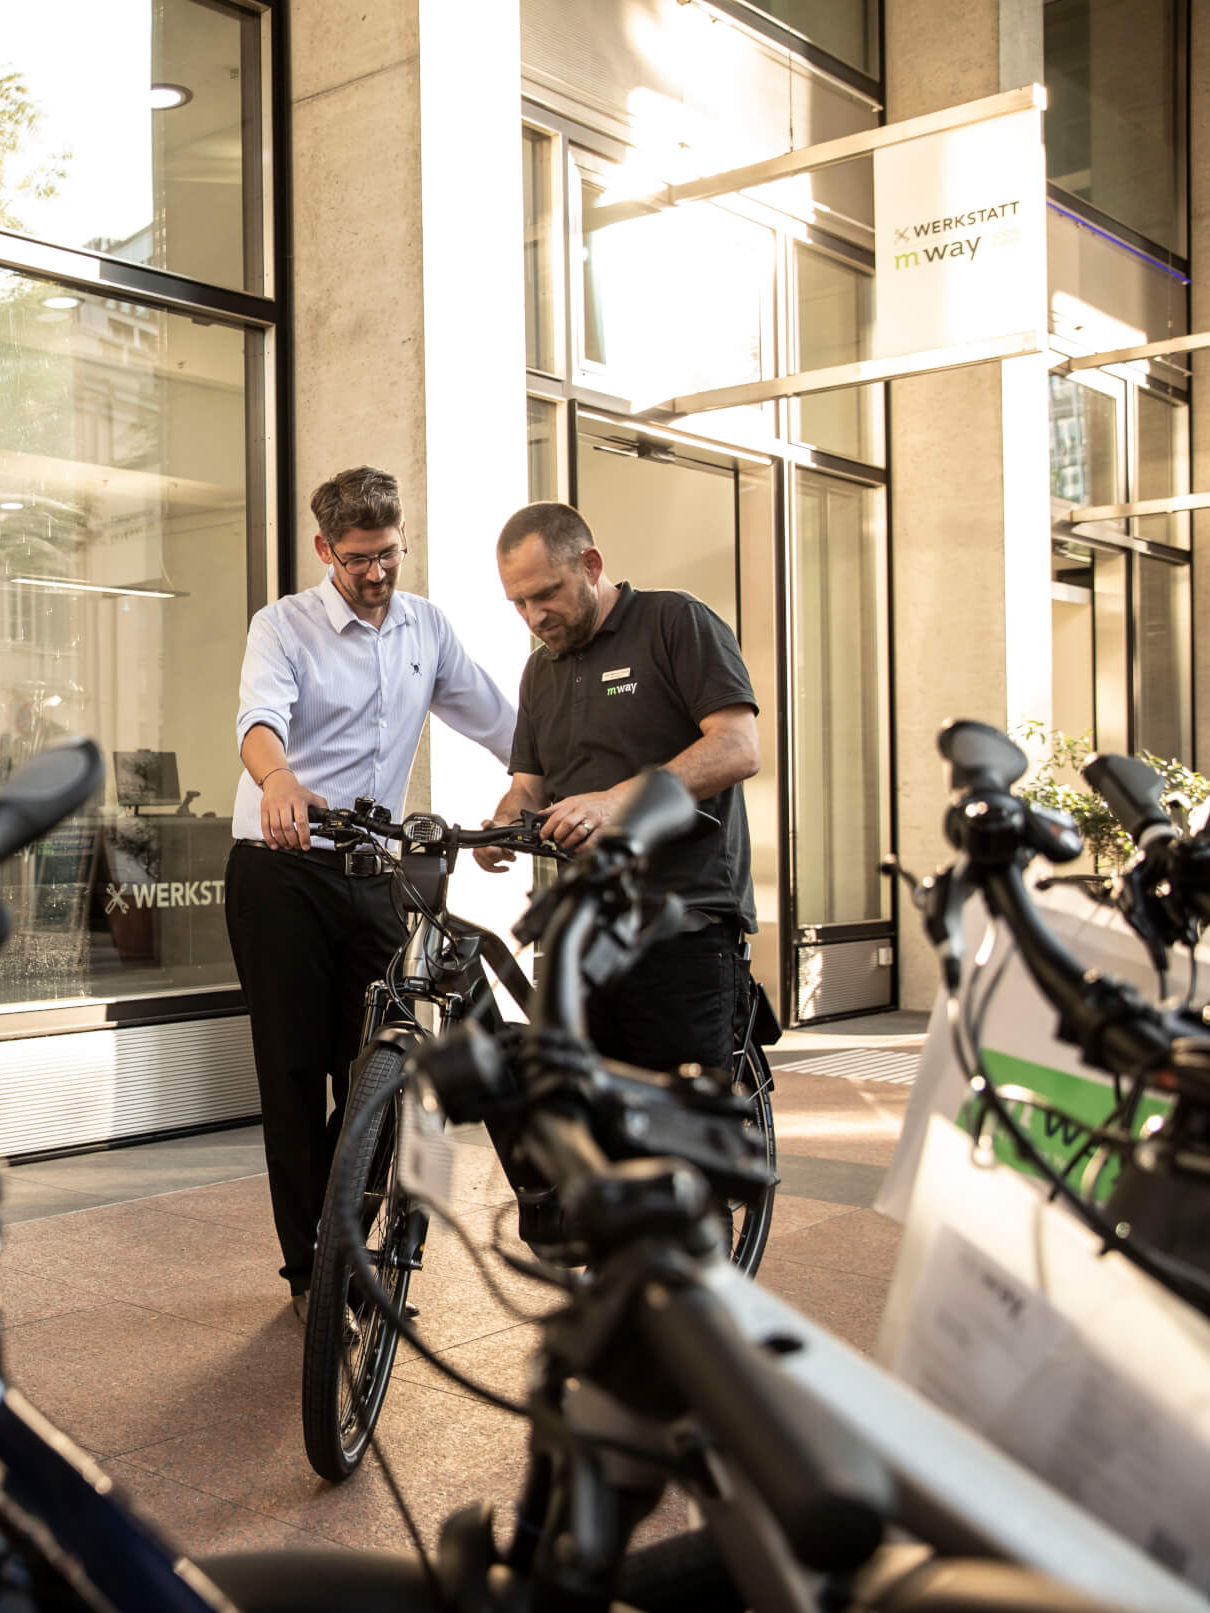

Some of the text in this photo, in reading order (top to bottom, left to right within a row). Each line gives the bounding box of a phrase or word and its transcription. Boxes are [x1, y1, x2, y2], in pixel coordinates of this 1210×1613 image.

[913, 200, 1020, 238] WERKSTATT
[607, 682, 638, 696] mway
[132, 880, 225, 909] WERKST
